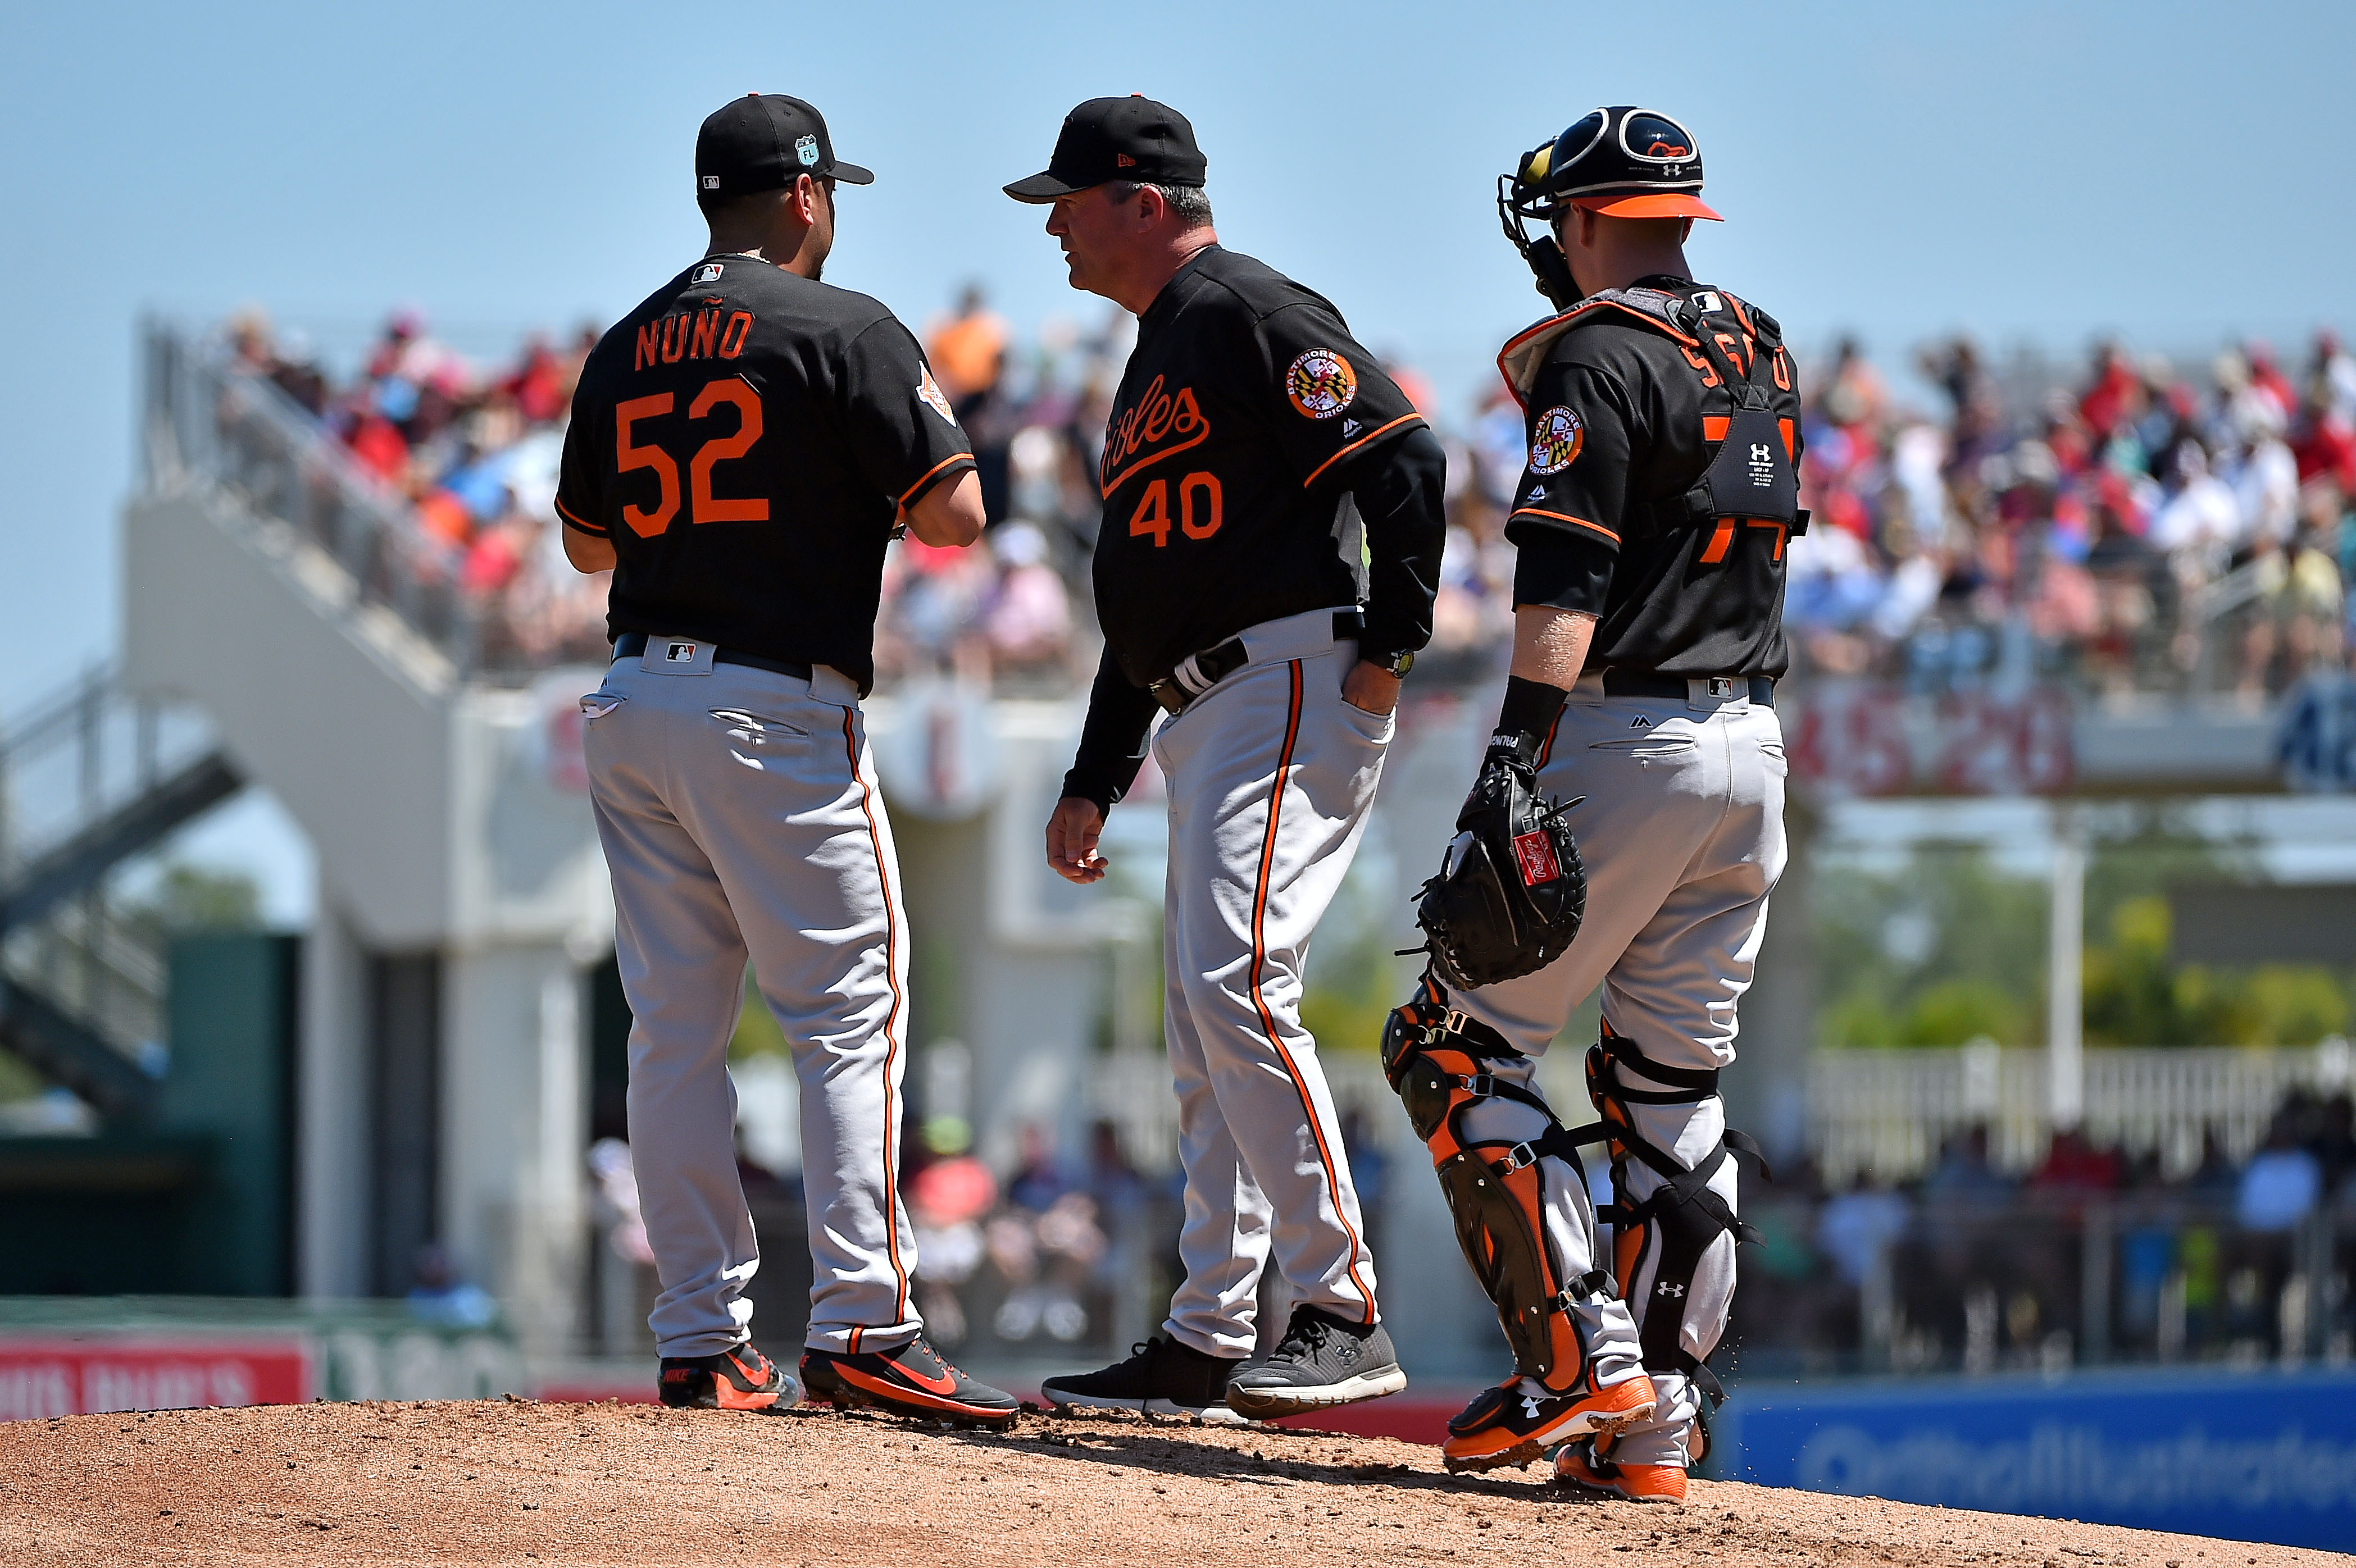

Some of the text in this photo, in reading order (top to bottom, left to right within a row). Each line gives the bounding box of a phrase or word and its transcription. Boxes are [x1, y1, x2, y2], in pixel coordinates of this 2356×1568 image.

[803, 149, 815, 160] FL
[635, 296, 756, 371] NUÑO
[1286, 350, 1336, 395] BALTIMORE
[1315, 385, 1356, 419] ORIOLES
[1535, 408, 1580, 436] BALTIMORE
[616, 377, 769, 539] 52
[1529, 459, 1570, 475] ORIOLES
[1129, 471, 1224, 548] 40
[1524, 839, 1547, 878] Rawlings
[663, 1368, 690, 1383] NIKE
